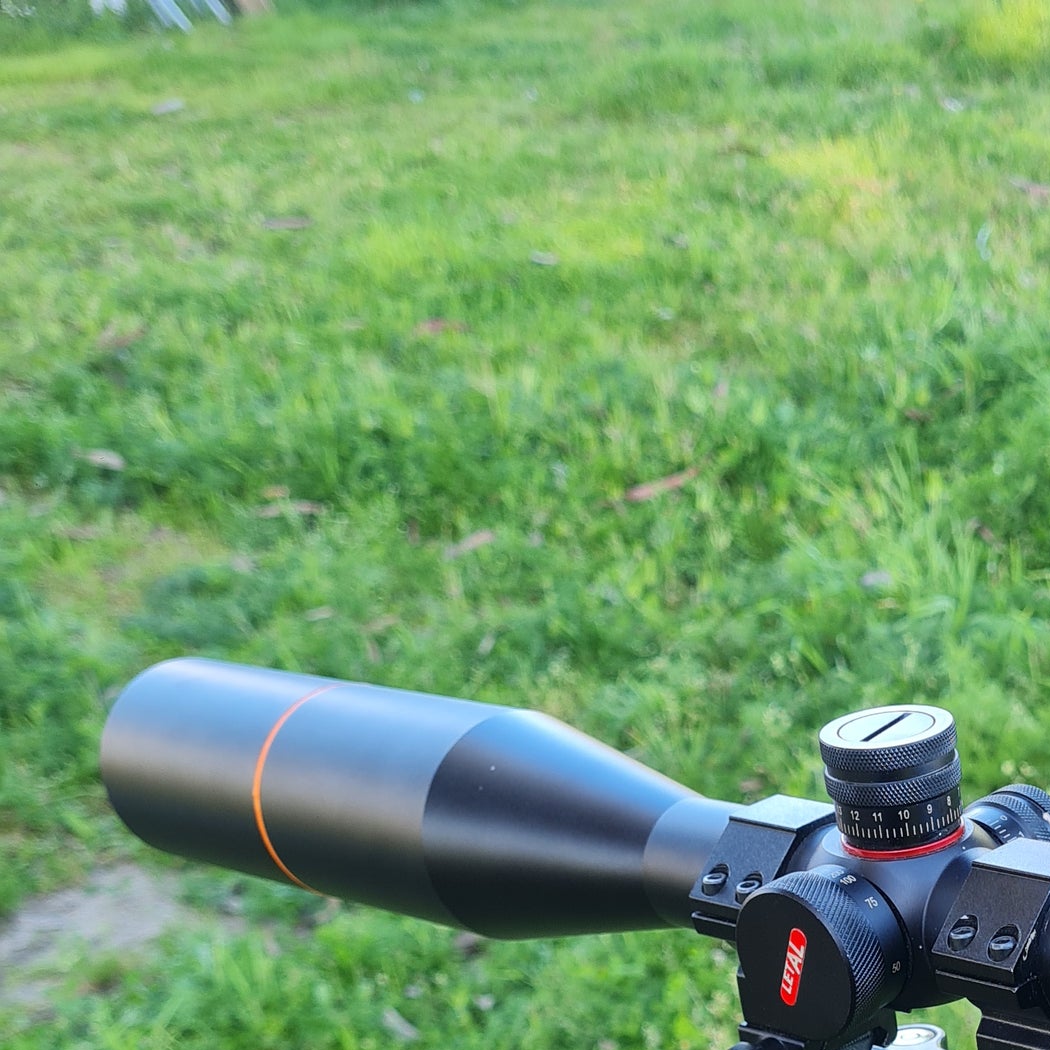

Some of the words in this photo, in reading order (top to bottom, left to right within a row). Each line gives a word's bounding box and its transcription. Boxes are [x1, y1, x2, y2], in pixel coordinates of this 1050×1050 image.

[850, 809, 860, 821] 12
[872, 812, 883, 823] 11
[898, 809, 910, 821] 10
[926, 804, 933, 814] 9
[946, 795, 952, 806] 8
[840, 874, 857, 886] 100
[864, 896, 879, 909] 75
[892, 961, 901, 974] 50
[781, 940, 805, 995] LETAL
